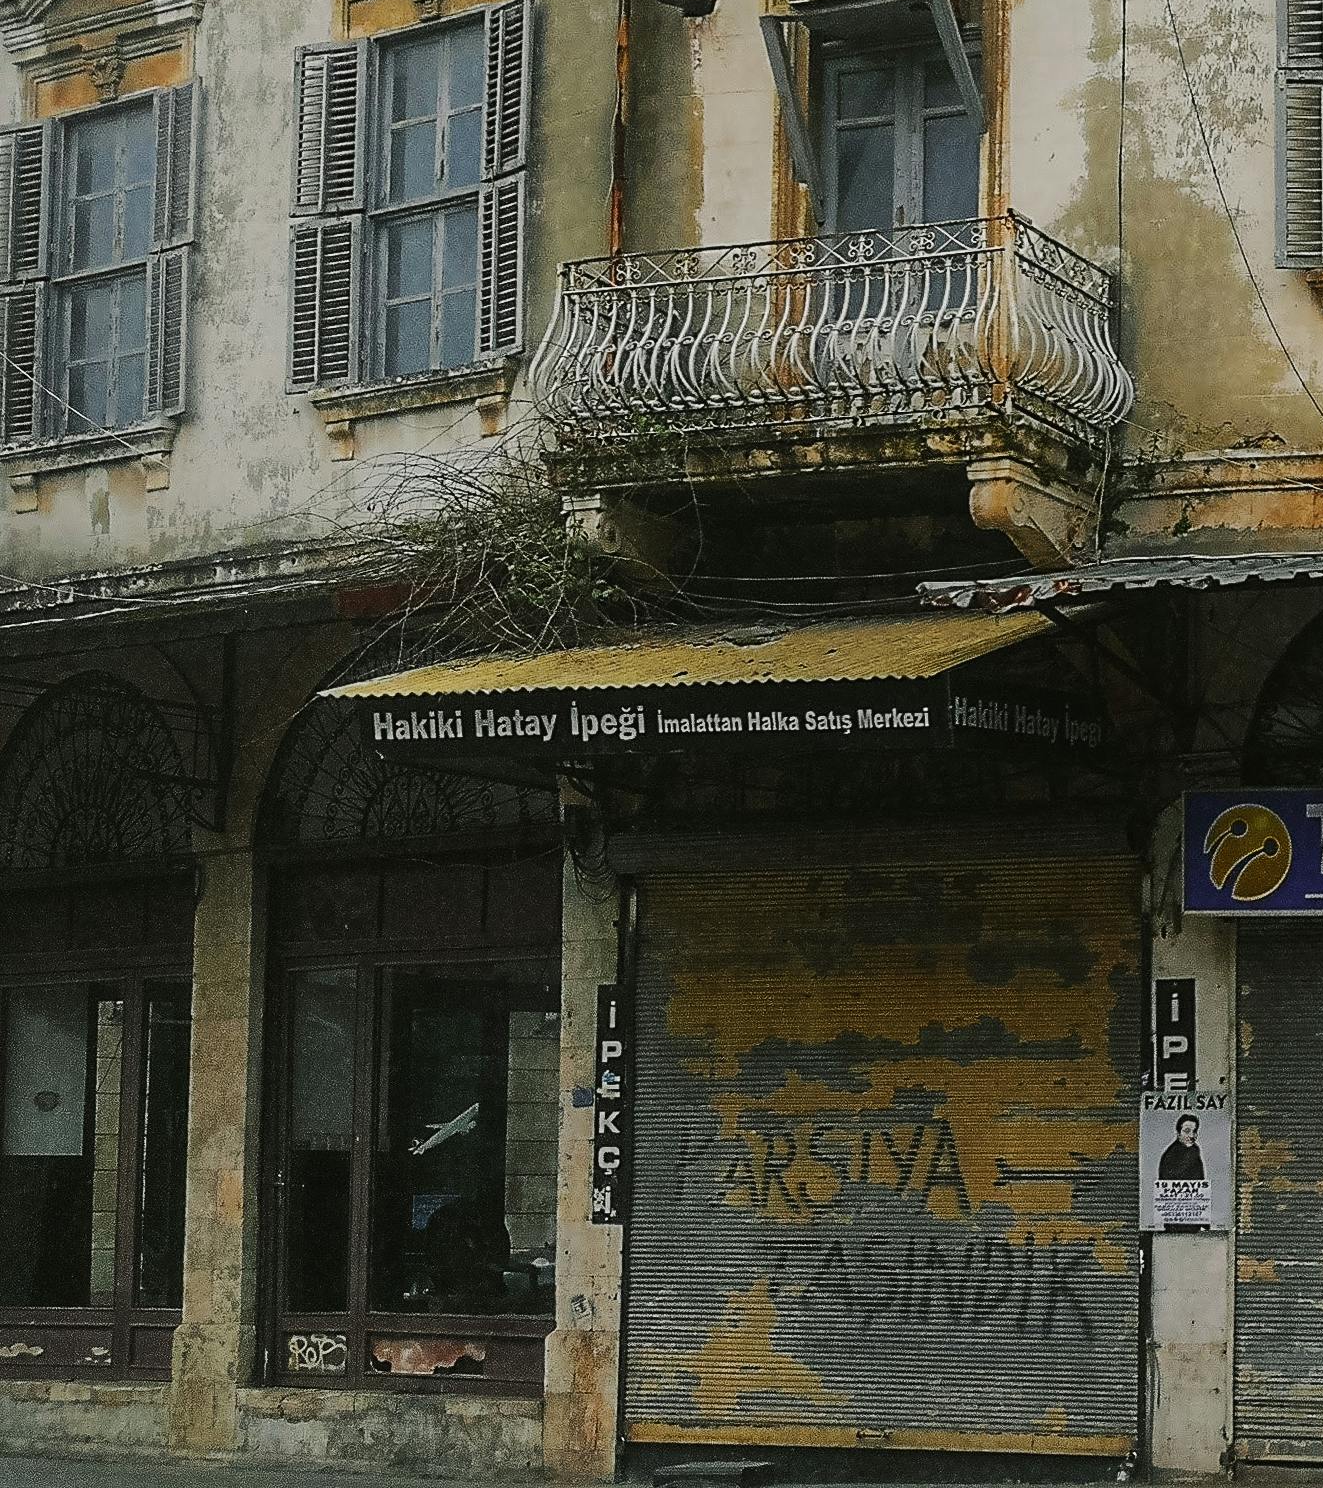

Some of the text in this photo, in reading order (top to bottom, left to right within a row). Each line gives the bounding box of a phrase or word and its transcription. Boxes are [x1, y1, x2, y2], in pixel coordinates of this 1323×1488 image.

[373, 700, 930, 742] Hakiki Hatay İpeği İmalattan Halka Satış Merkezi
[953, 695, 1009, 732] Hakiki
[1014, 704, 1060, 744] Hatay
[1144, 1094, 1228, 1110] FAZIL SAY
